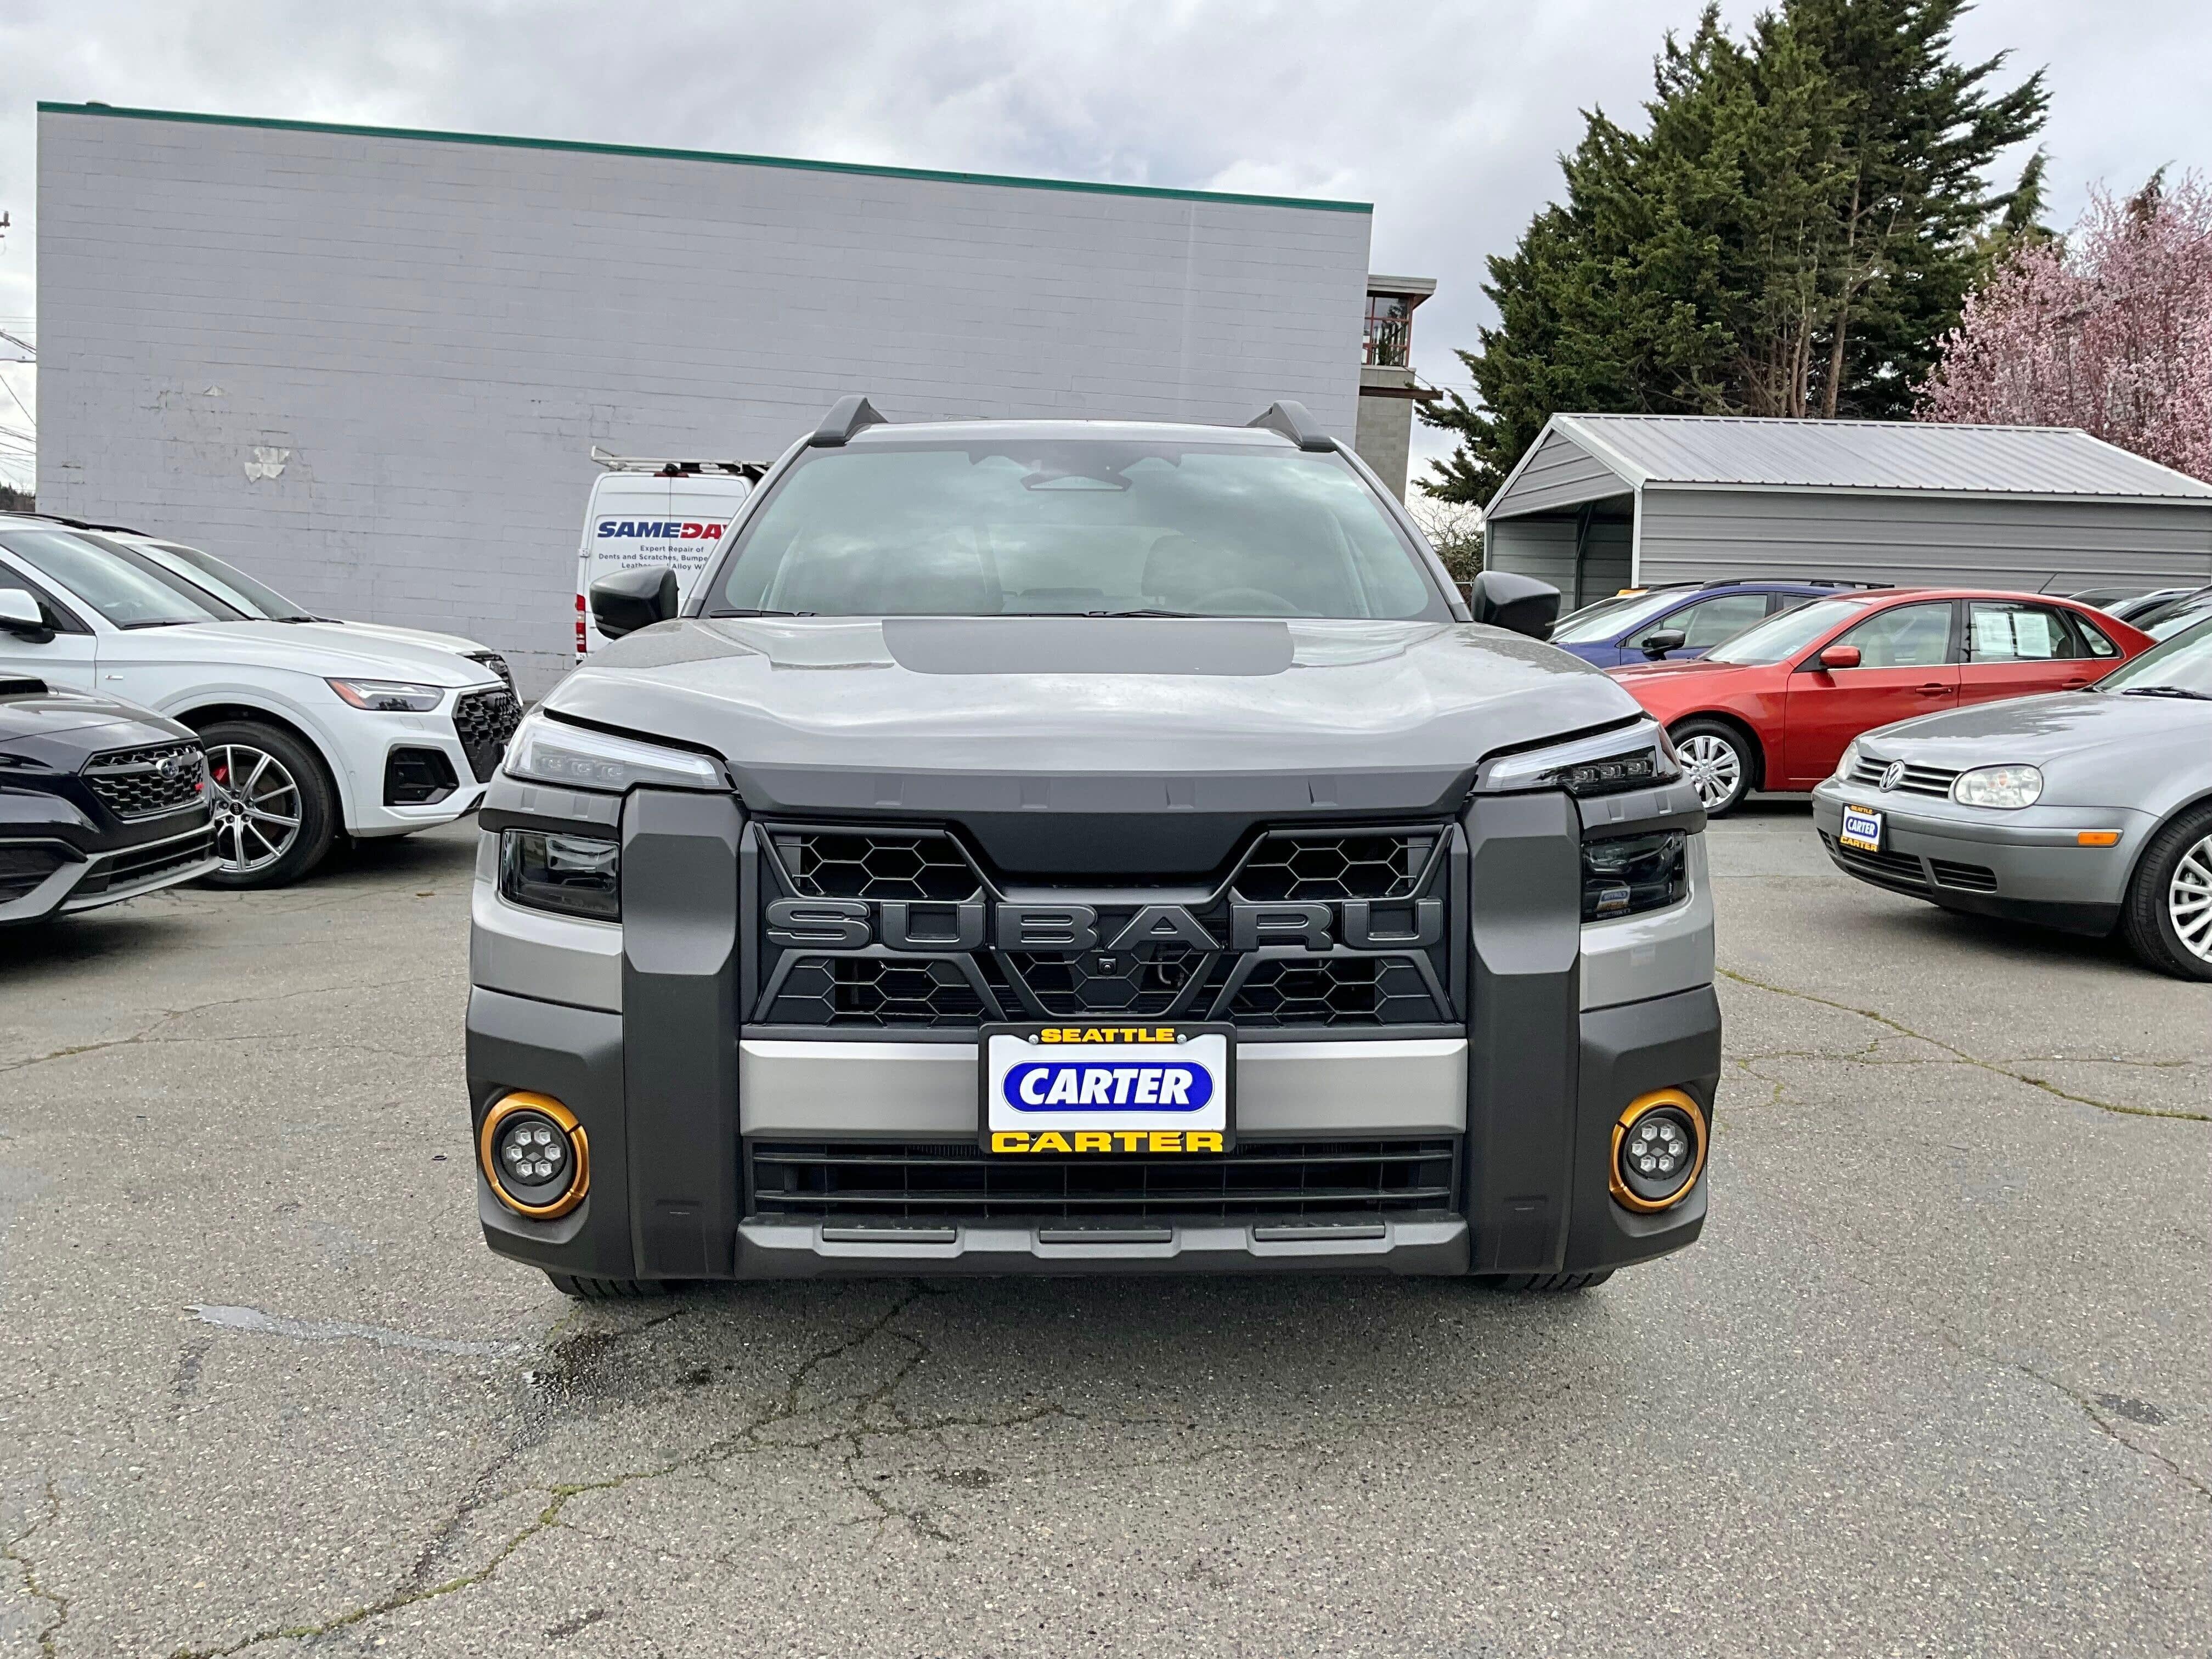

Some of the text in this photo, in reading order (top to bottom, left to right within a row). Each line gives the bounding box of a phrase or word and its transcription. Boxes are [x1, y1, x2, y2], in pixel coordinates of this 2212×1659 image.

[597, 521, 727, 539] SAMEDA
[1851, 805, 1873, 815] SEATTLE
[1847, 818, 1875, 836] CARTER
[1840, 836, 1877, 852] CARTER
[766, 899, 1444, 952] SUBARU
[1041, 1028, 1175, 1042] SEATTLE
[1019, 1068, 1193, 1105] CARTER
[991, 1132, 1223, 1152] CARTER
